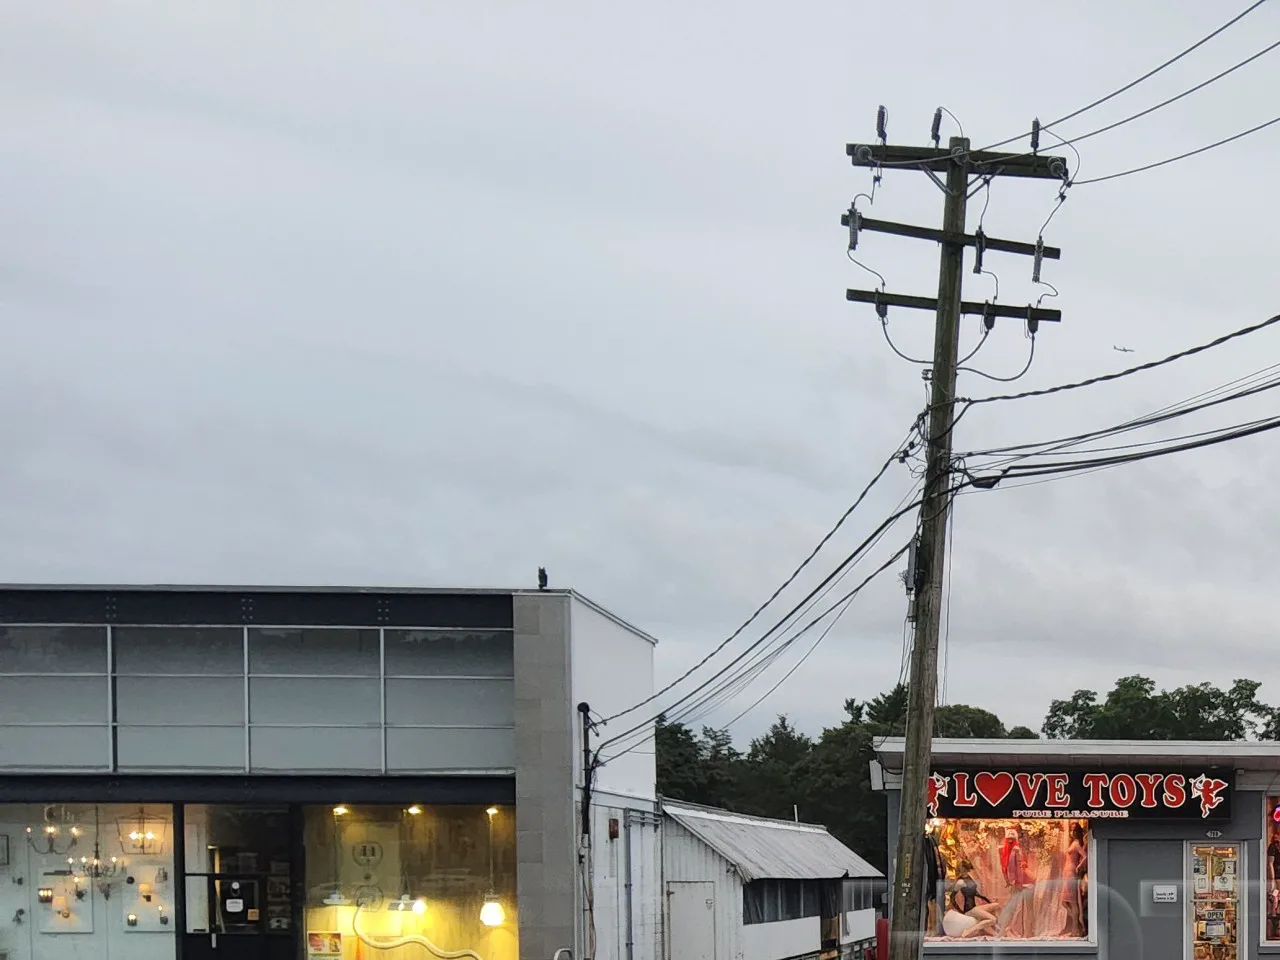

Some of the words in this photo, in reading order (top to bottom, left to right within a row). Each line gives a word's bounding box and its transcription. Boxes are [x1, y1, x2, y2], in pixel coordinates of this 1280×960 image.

[1083, 772, 1186, 808] TOYS
[1012, 810, 1051, 818] PURE
[1054, 810, 1129, 818] PLEASURE
[1206, 911, 1224, 919] OPEN
